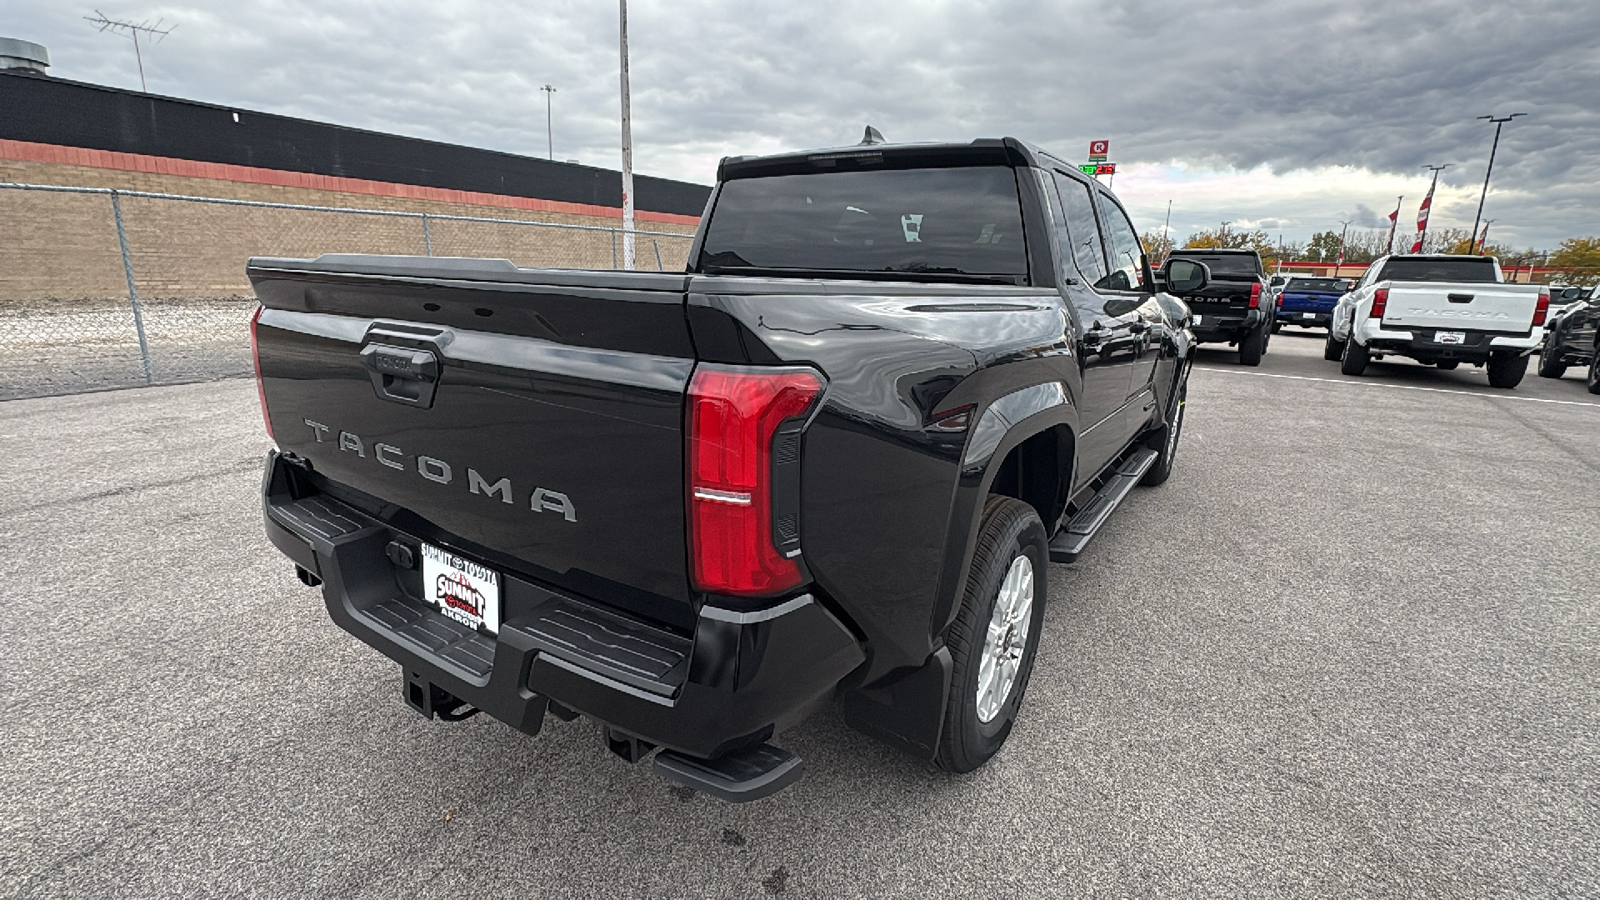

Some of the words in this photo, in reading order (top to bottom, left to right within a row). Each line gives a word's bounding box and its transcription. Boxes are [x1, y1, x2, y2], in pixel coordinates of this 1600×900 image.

[1408, 307, 1509, 319] TACOMA
[303, 417, 578, 523] TACOMA
[421, 542, 453, 567] SUMMIT
[463, 560, 498, 586] TOYOTA
[437, 575, 486, 618] SUMMIT
[441, 607, 478, 631] AKRON
